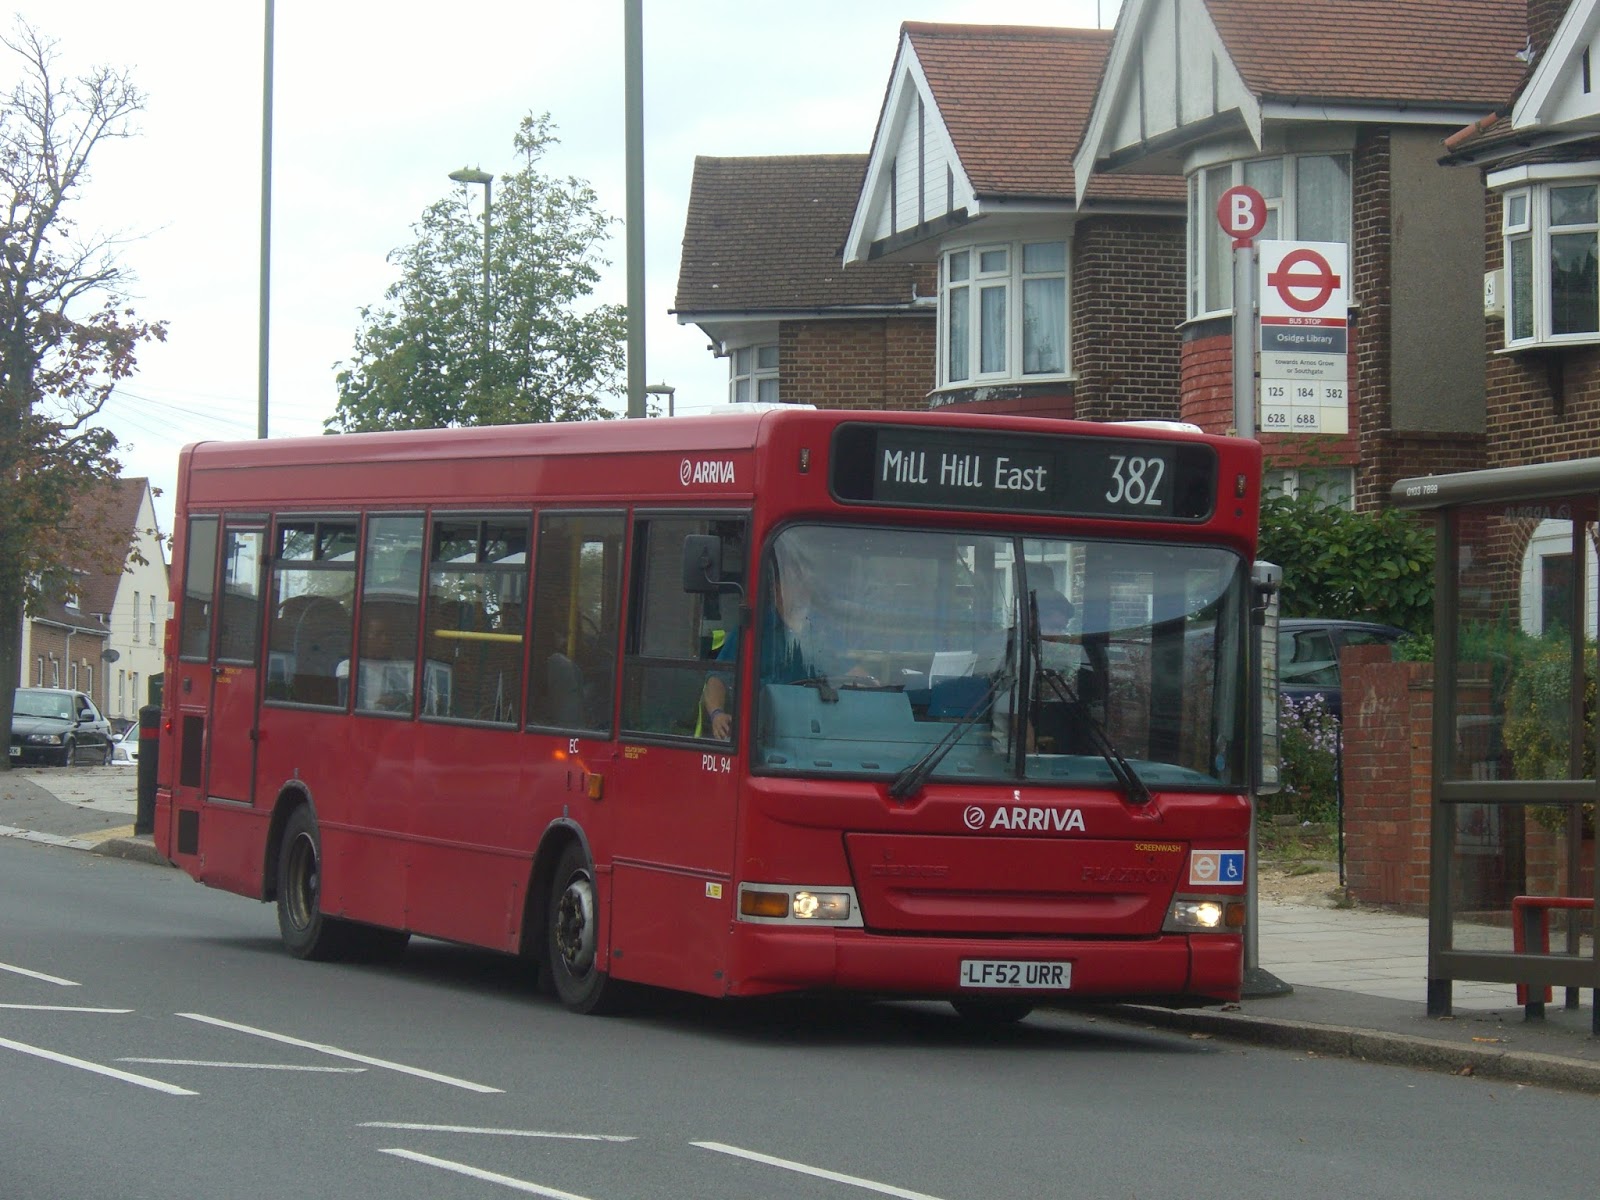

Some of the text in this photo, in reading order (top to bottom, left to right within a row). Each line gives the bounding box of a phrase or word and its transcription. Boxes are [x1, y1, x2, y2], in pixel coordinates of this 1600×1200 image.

[1231, 194, 1255, 231] B
[1289, 317, 1302, 325] BUS
[1276, 333, 1333, 345] Osidge Library
[1294, 368, 1324, 376] Southgate
[1268, 387, 1284, 397] 125
[1297, 387, 1314, 398] 184
[1326, 388, 1343, 399] 382
[1267, 413, 1286, 424] 628
[1296, 414, 1316, 424] 688
[692, 460, 736, 484] ARRIVA
[882, 449, 1048, 492] Mill Hill East
[1105, 455, 1166, 506] 382
[569, 738, 579, 753] EC
[702, 754, 731, 773] PDL 94
[989, 806, 1087, 833] ARRIVA
[1134, 843, 1182, 853] SCREENWASH
[968, 963, 1064, 984] LF52 URR
